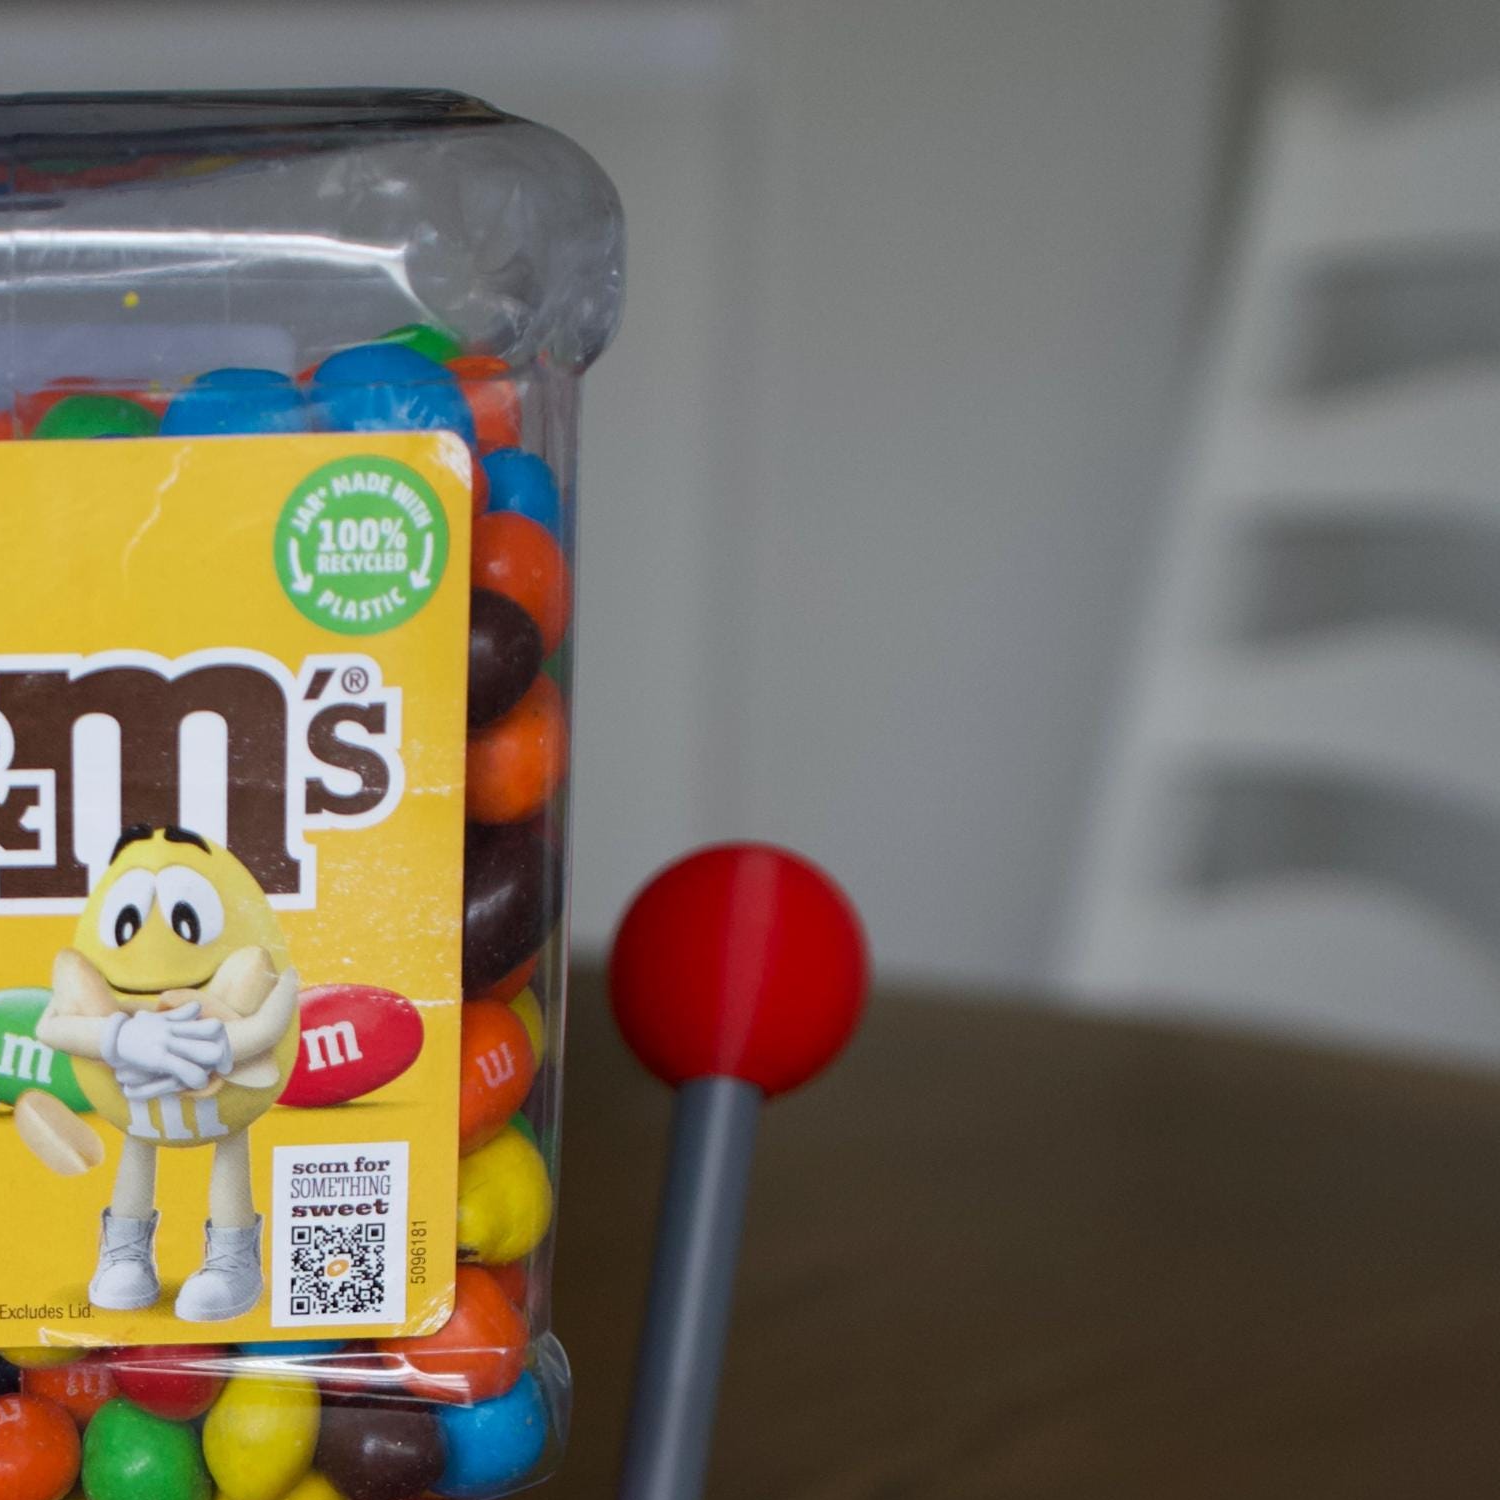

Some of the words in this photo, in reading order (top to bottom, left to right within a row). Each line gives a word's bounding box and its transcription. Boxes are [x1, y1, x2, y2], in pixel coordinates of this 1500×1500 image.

[331, 472, 393, 498] MADE
[392, 481, 434, 530] WITH
[318, 517, 409, 551] 100%
[317, 551, 409, 574] RECYCLED
[317, 586, 408, 622] PLASTIC
[292, 1161, 350, 1175] scan
[355, 1156, 391, 1172] for
[291, 1175, 392, 1199] SOMETHING
[291, 1198, 390, 1218] sweet
[411, 1219, 427, 1284] 5096181
[69, 1303, 95, 1319] Lid.
